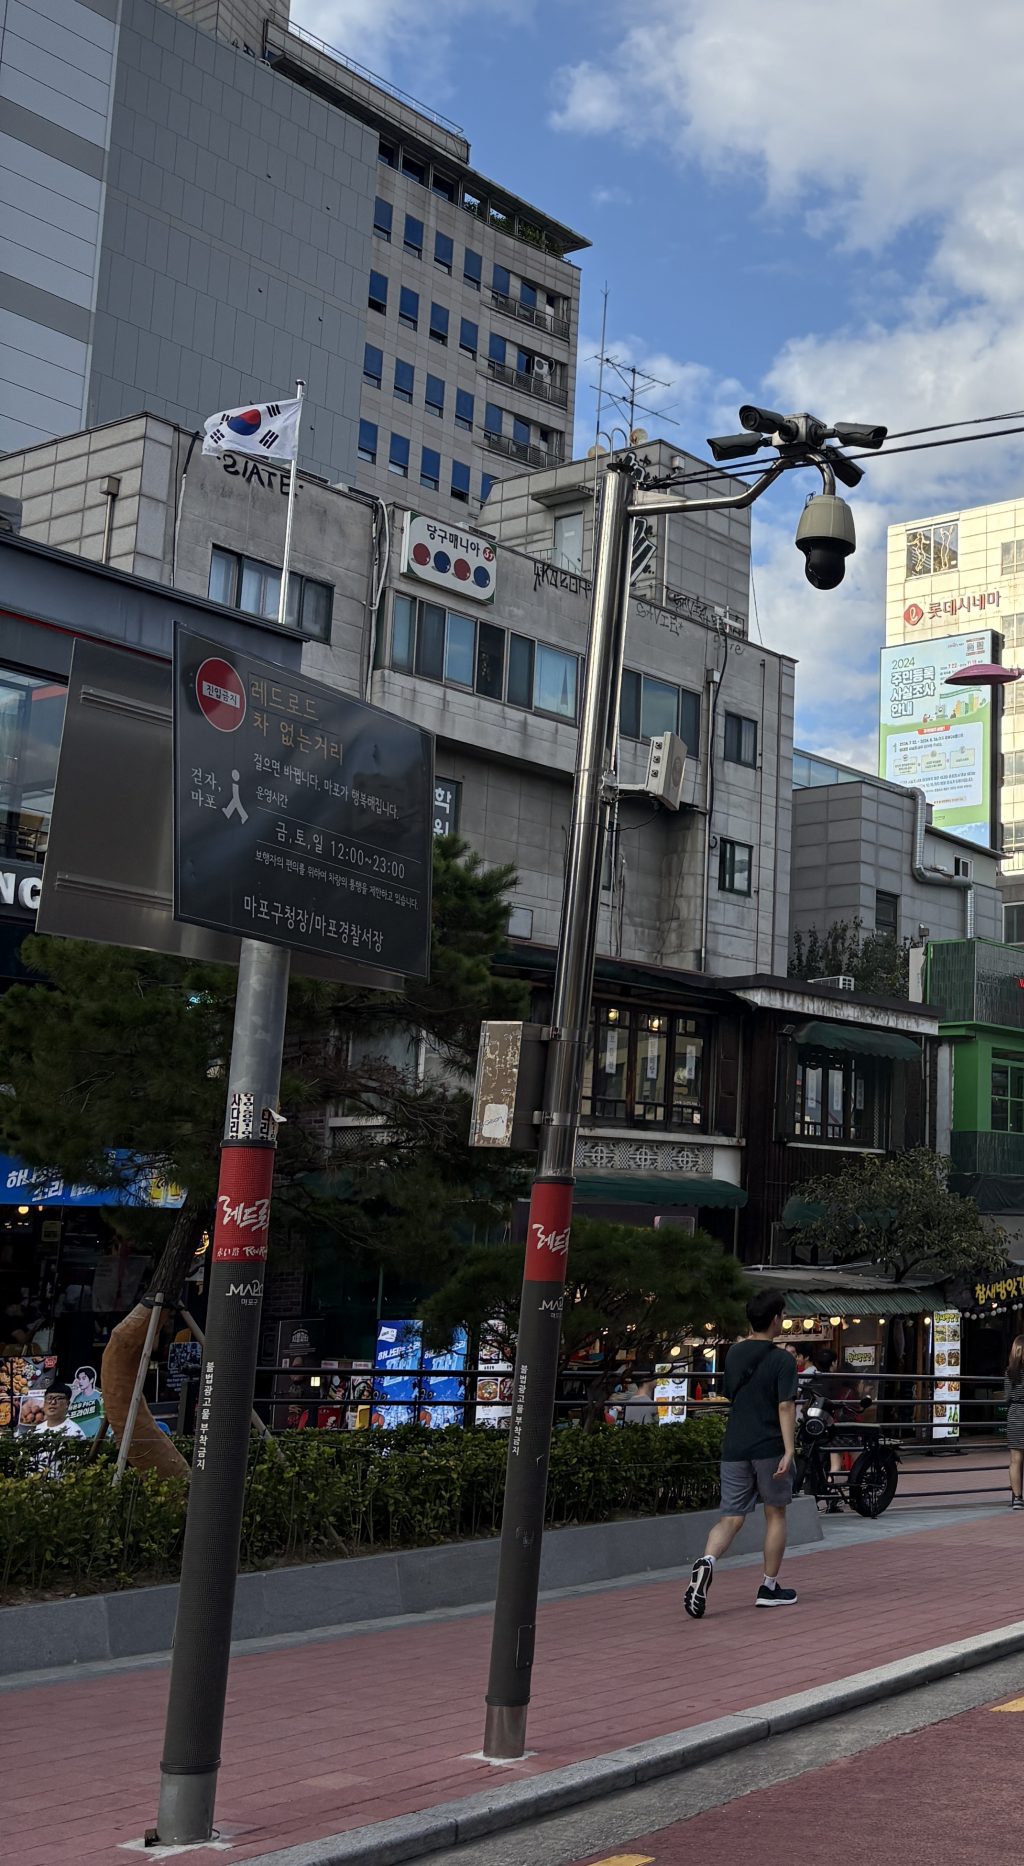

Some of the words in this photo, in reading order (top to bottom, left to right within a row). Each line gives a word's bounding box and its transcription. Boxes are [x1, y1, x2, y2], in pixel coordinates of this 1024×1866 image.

[427, 523, 480, 557] 당구매니아
[927, 590, 1001, 620] 롯데시네마
[891, 665, 935, 686] 주민등록
[892, 657, 915, 670] 2024
[206, 684, 237, 705] 진입금지
[250, 680, 319, 720] 레드로드
[890, 682, 935, 702] 사실조사
[891, 701, 913, 718] 안내
[253, 712, 269, 736] 차
[280, 722, 343, 766] 없는거리
[191, 767, 221, 792] 걷자,
[191, 789, 217, 809] 마포
[254, 753, 280, 777] 걸으면
[324, 780, 349, 801] 마포가
[352, 789, 399, 820] 행복해집니다.
[256, 785, 288, 808] 운영시간
[433, 788, 451, 838] 학원
[275, 821, 323, 854] 금,토,일
[331, 840, 405, 879] 12:00~23:00
[256, 849, 284, 869] 보행자의
[286, 859, 305, 876] 편의를
[307, 865, 327, 883] 위하여
[329, 872, 348, 888] 차량의
[349, 878, 368, 894] 통행을
[369, 885, 393, 901] 제한하고
[395, 894, 418, 910] 있습니다.
[244, 895, 384, 953] 마포구청장/마포경찰서장
[202, 1361, 216, 1420] 불법광고물
[515, 1365, 529, 1414] 불법광고물
[197, 1423, 208, 1470] 부착금지
[511, 1416, 523, 1456] 부착금지
